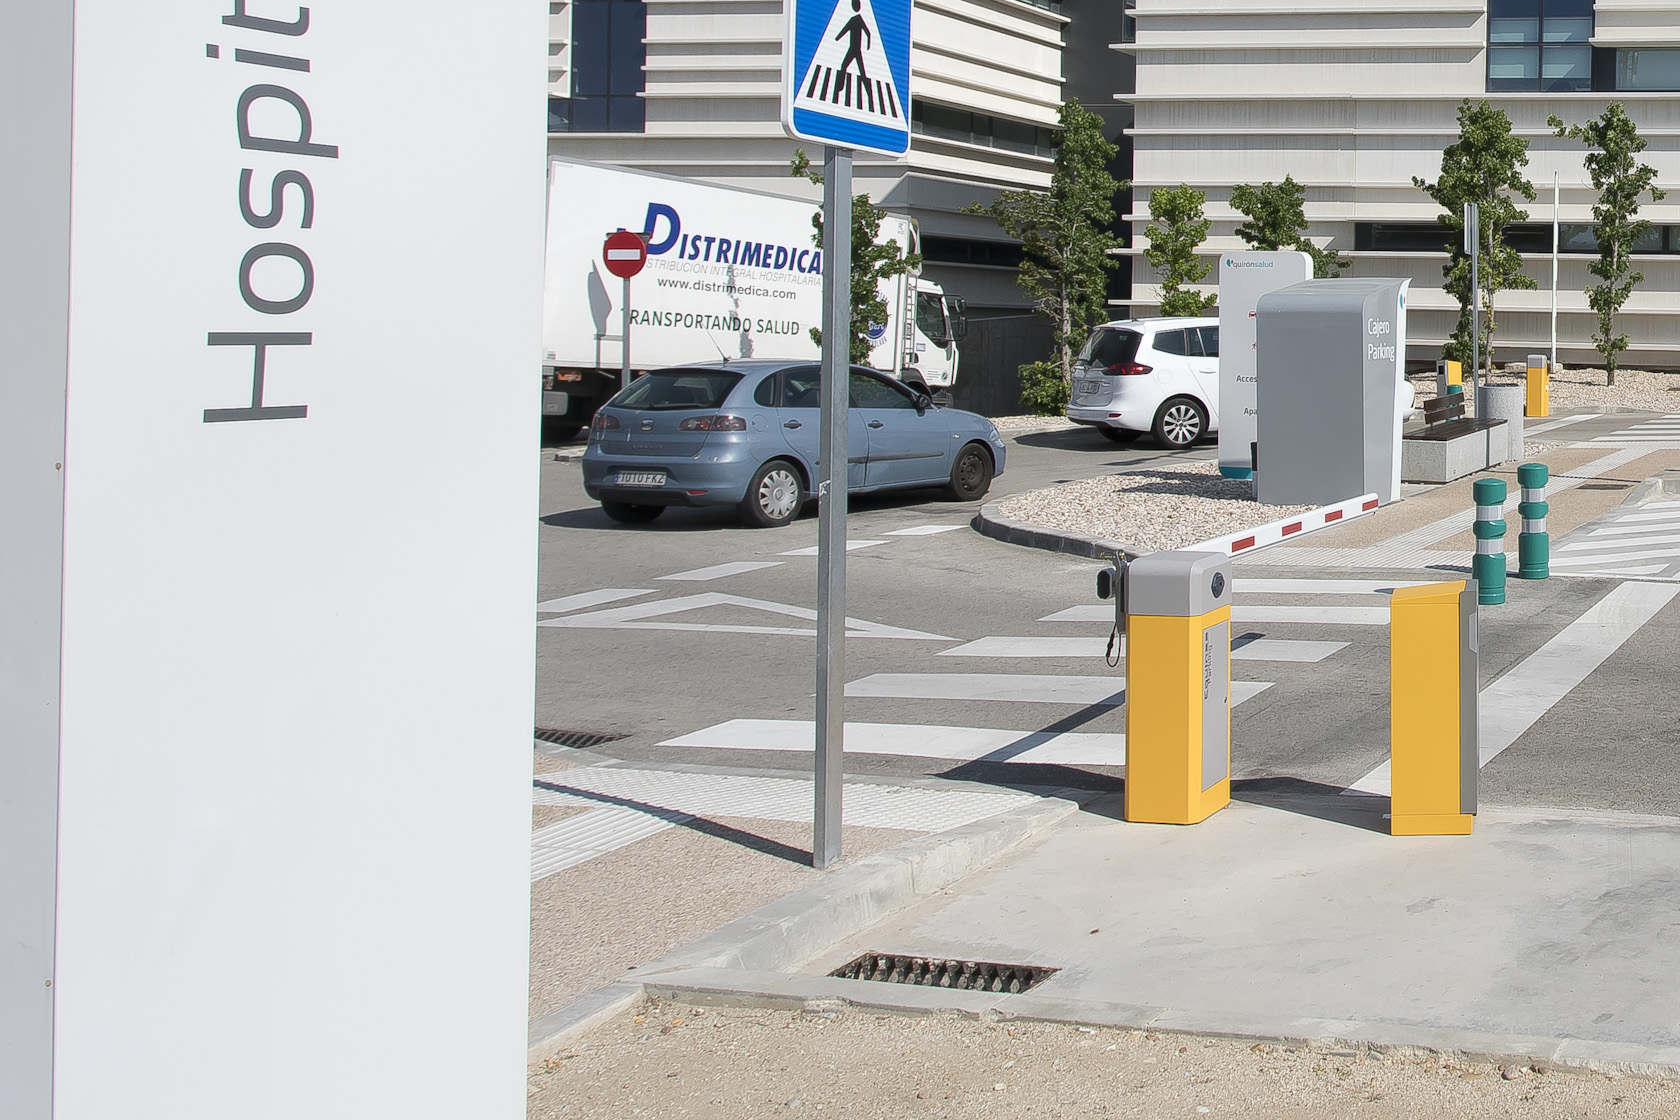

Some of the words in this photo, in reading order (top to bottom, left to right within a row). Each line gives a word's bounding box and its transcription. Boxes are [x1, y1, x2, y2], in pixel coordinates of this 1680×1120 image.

[643, 202, 821, 275] DISTRIMEDICA
[646, 258, 708, 274] STRIBUCIÓN
[710, 265, 757, 280] INTEGRAL
[657, 278, 797, 300] www.distrimedica.com
[629, 309, 751, 333] RANSPORTANDO
[756, 319, 800, 335] SALUD
[1367, 317, 1390, 338] Cajero
[1367, 343, 1395, 362] Parking
[1236, 374, 1258, 383] Acces
